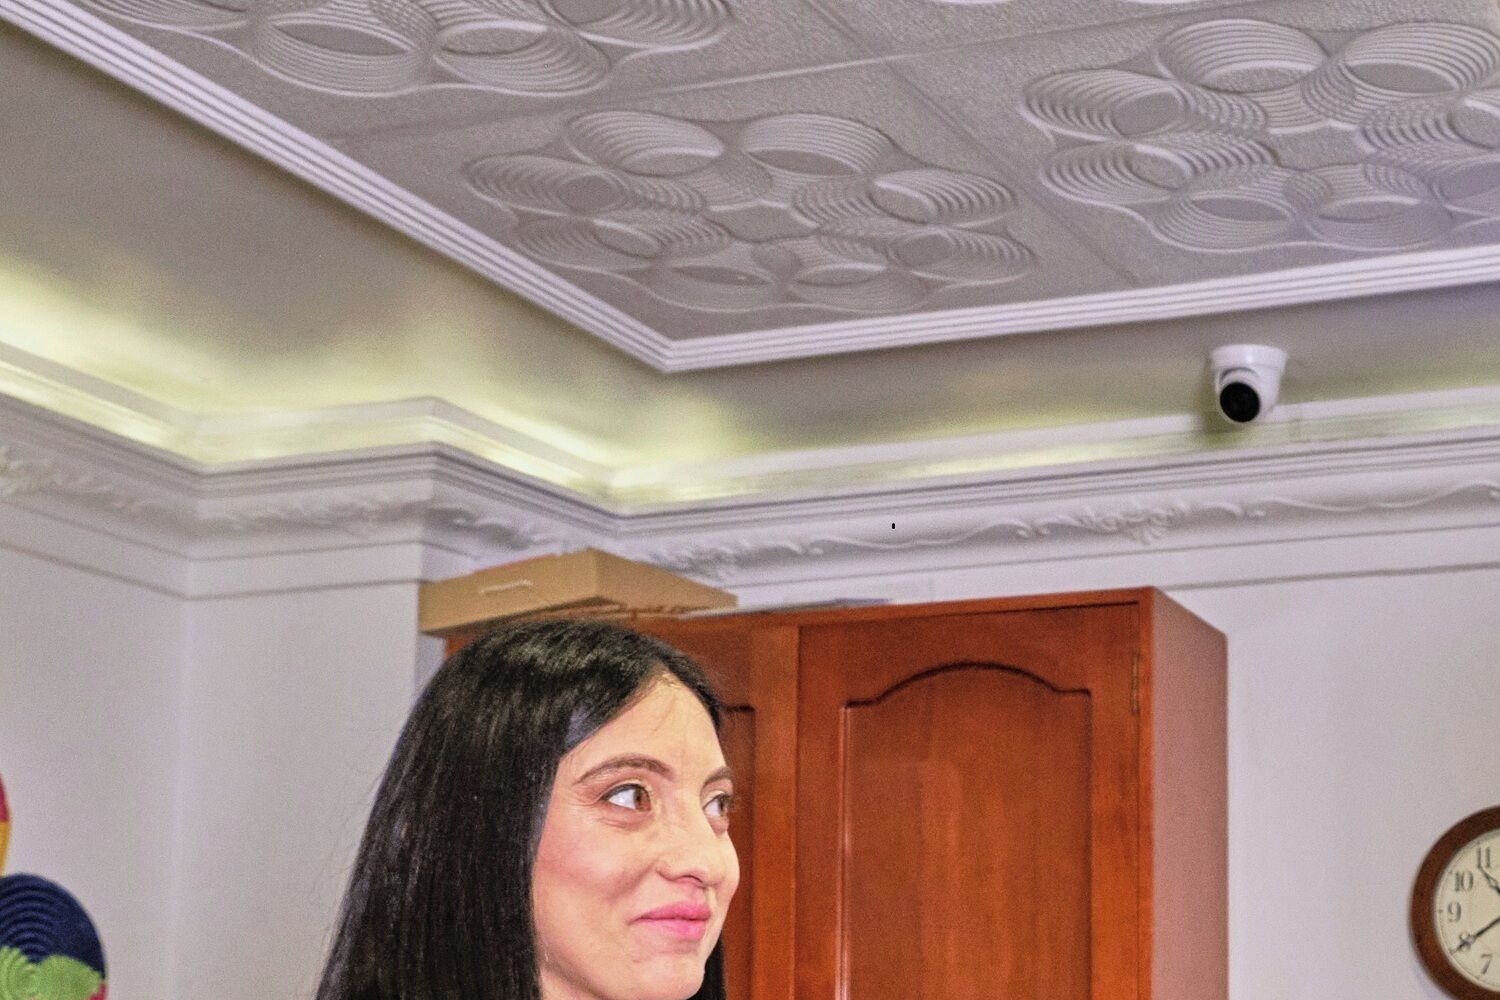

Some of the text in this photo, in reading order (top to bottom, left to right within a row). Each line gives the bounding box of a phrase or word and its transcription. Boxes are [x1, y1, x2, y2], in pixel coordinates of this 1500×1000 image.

[1476, 846, 1492, 869] 11
[1454, 871, 1475, 893] 10
[1447, 902, 1461, 922] 9
[1481, 953, 1493, 974] 7
